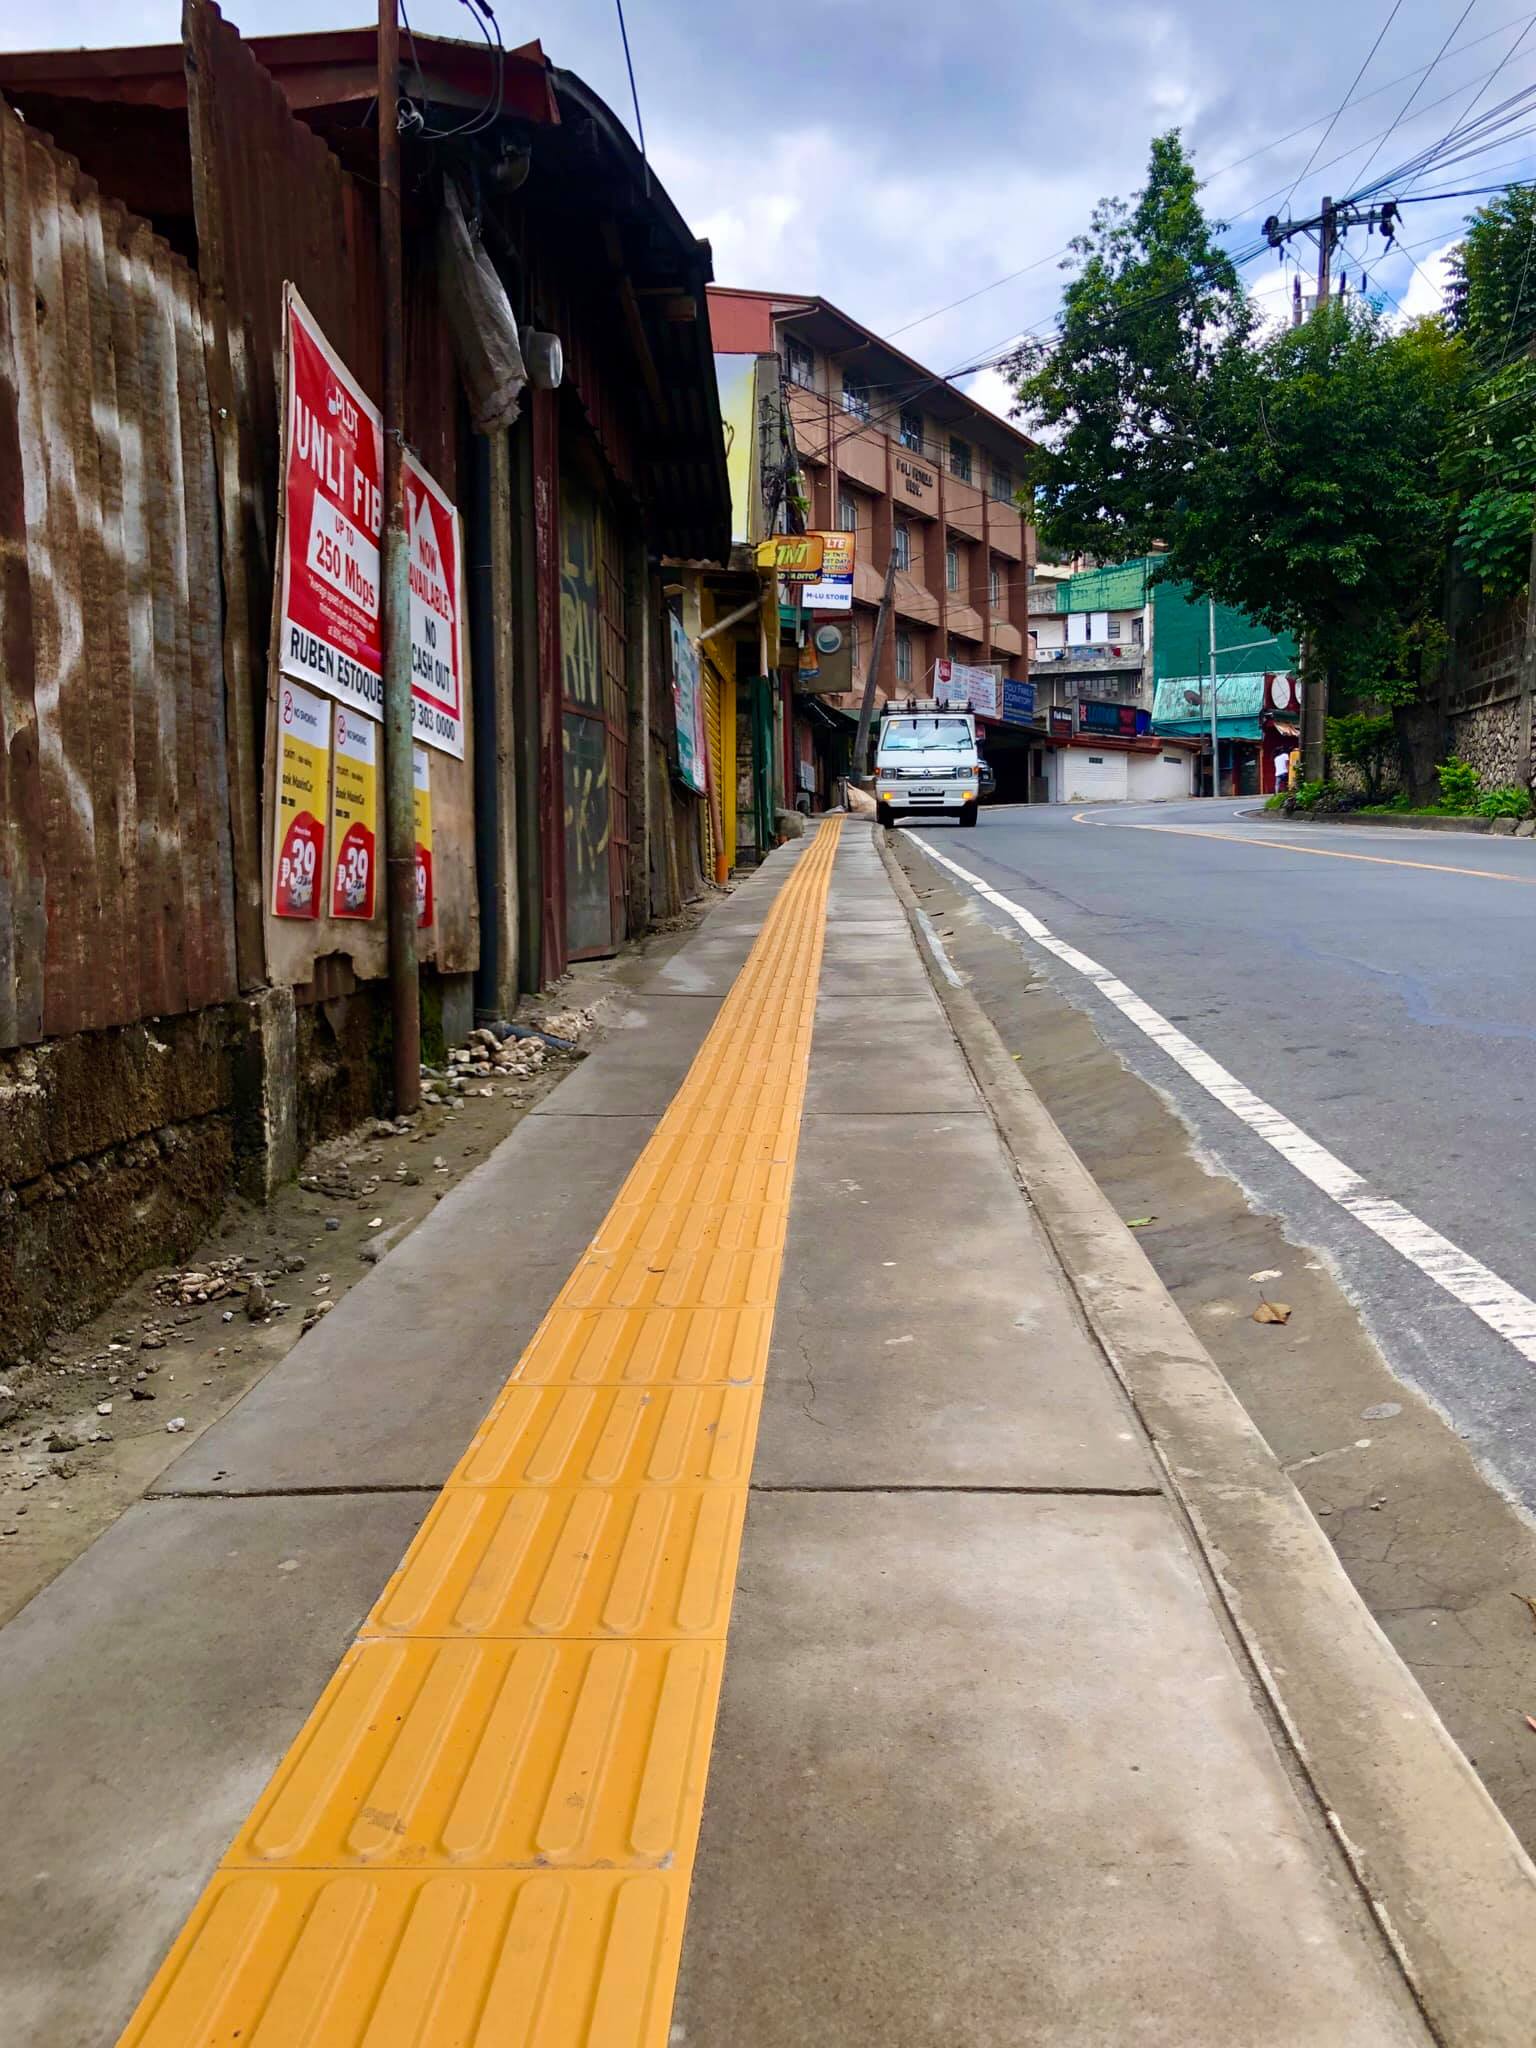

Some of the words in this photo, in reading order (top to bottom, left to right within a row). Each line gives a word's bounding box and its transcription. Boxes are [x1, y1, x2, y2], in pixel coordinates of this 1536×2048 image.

[335, 386, 358, 439] PLDT
[296, 394, 345, 501] UNLI
[353, 464, 382, 538] FIB
[335, 514, 345, 536] UP
[346, 525, 354, 547] TO
[826, 539, 846, 549] LTE
[316, 529, 341, 580] 250
[345, 552, 375, 609] Mbps
[418, 535, 438, 578] NOW
[777, 544, 809, 566] TNT
[409, 561, 450, 621] AVAILABLE
[826, 593, 849, 601] STORE
[424, 614, 437, 650] NO
[290, 627, 334, 681] RUBEN
[337, 654, 384, 706] ESTOQUE
[411, 643, 434, 679] CASH
[434, 659, 451, 694] OUT
[418, 703, 434, 732] 303
[435, 716, 456, 742] 0000
